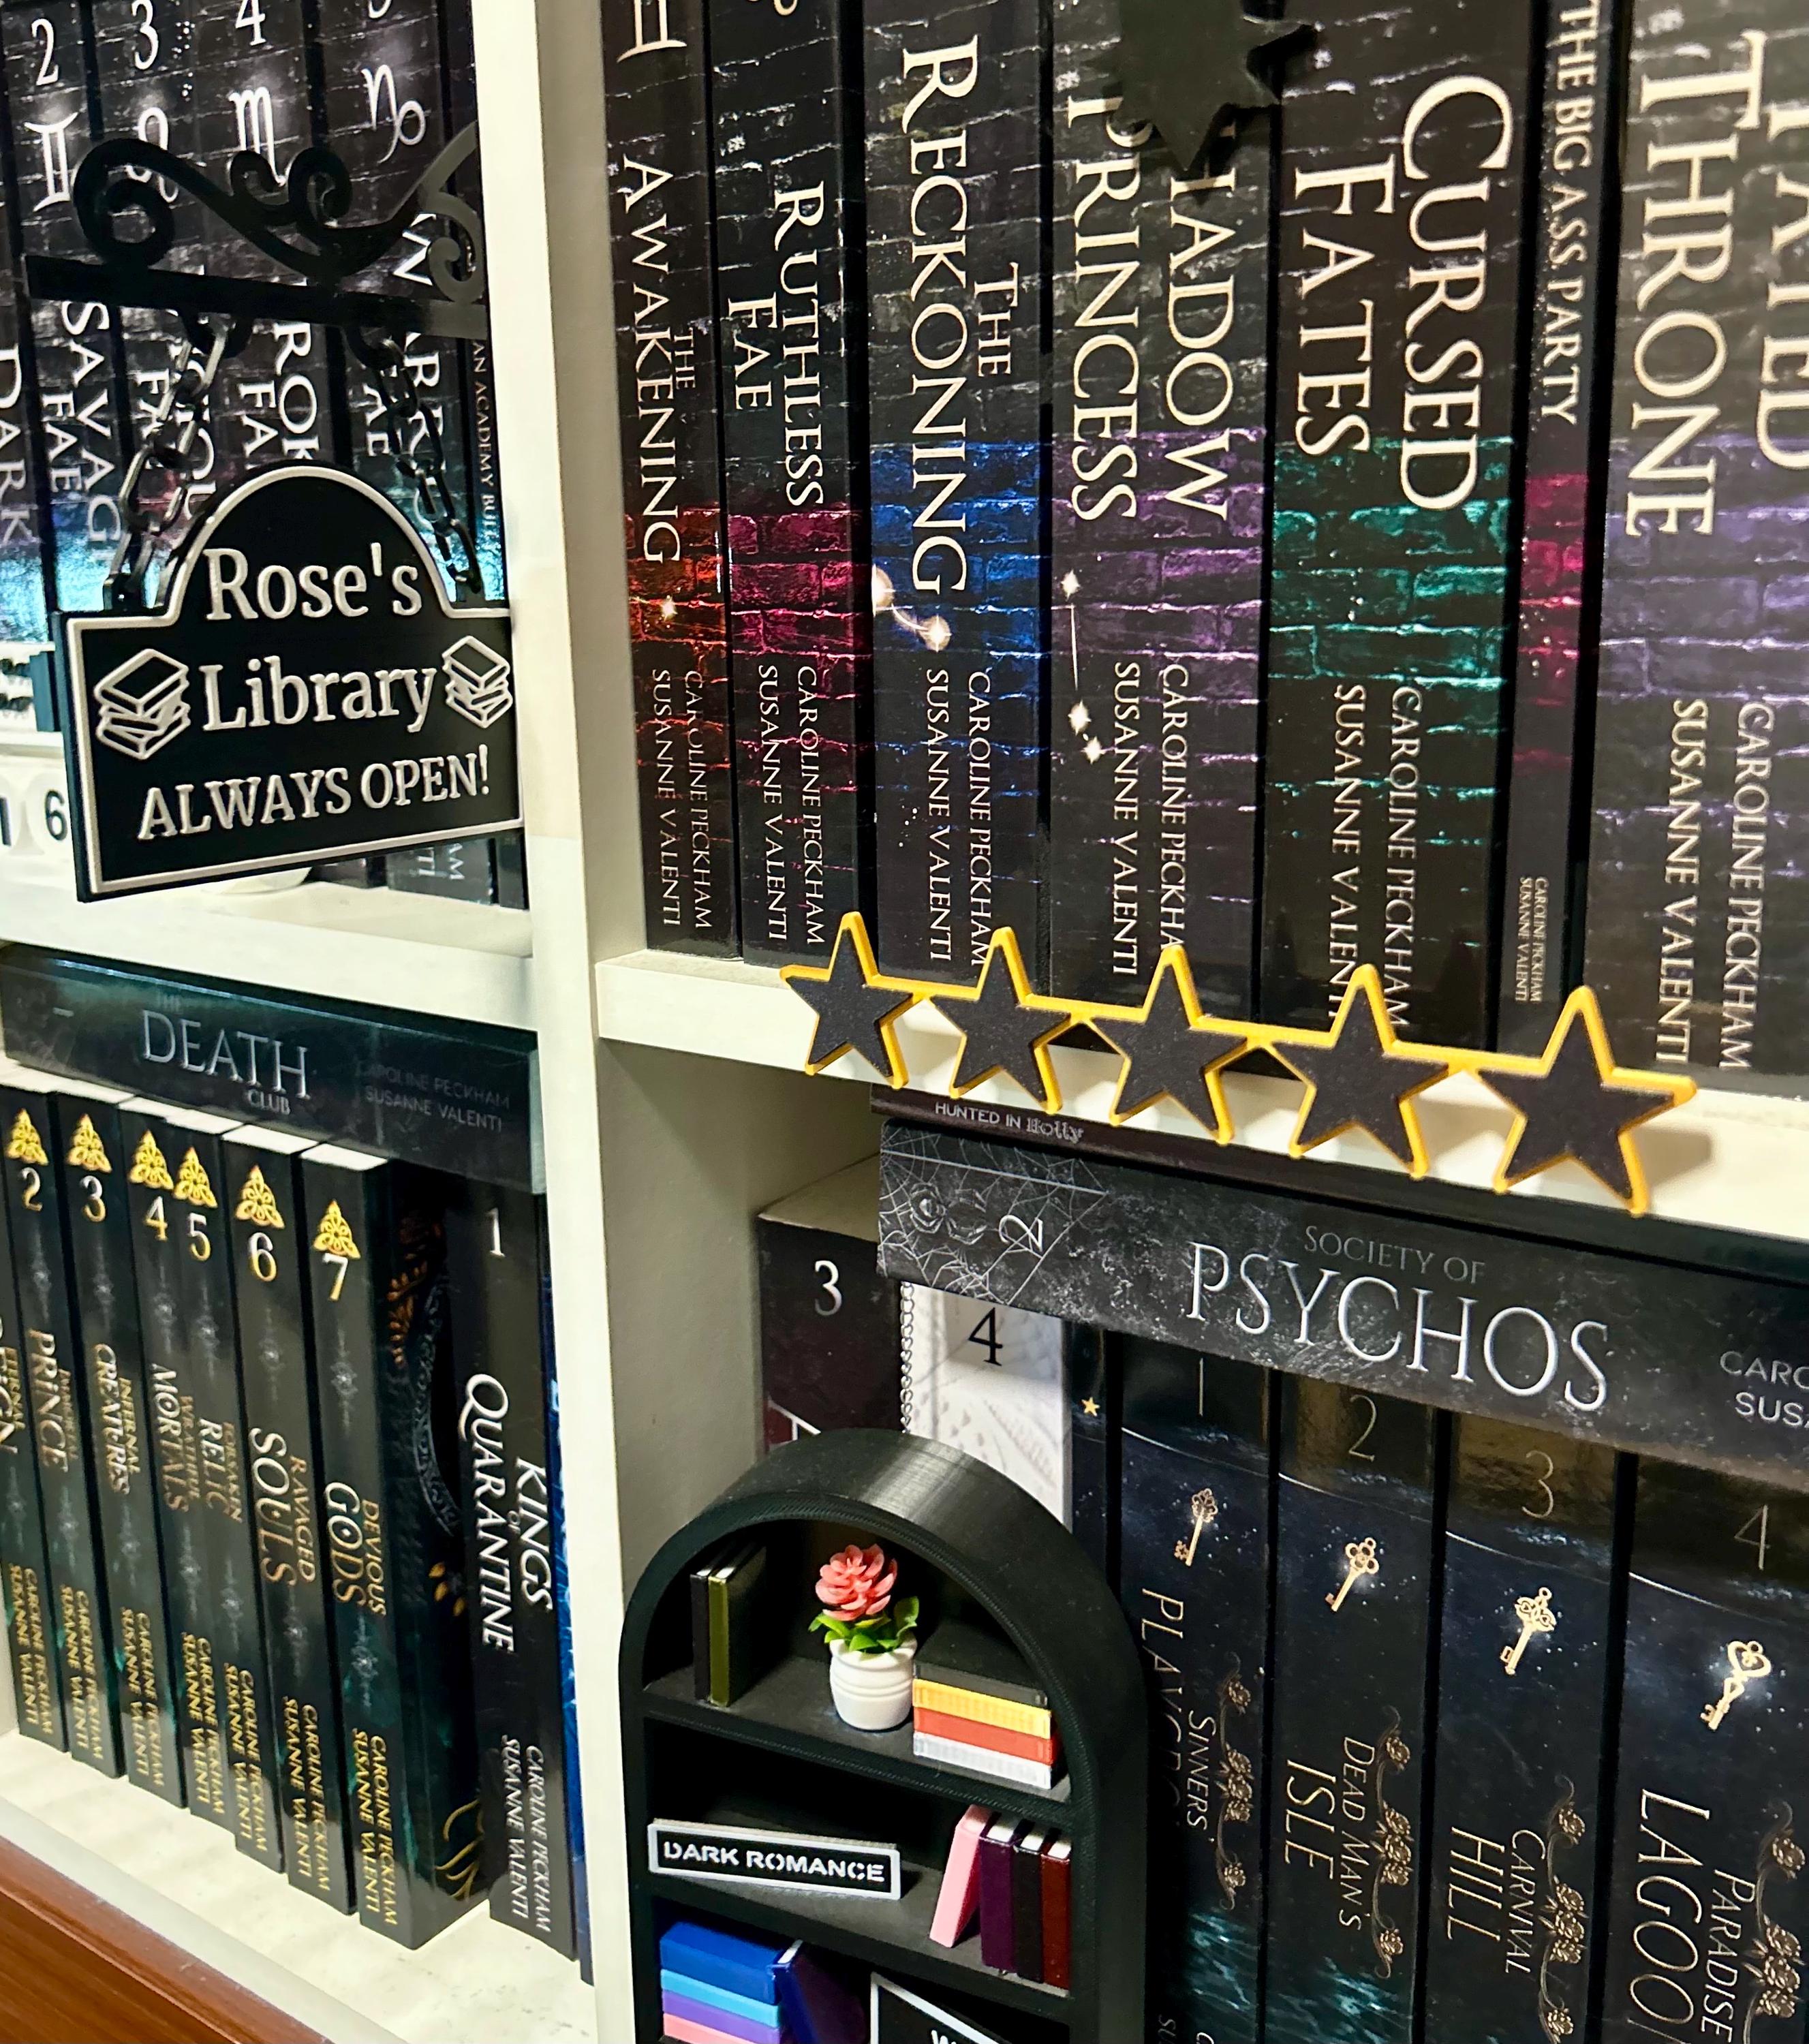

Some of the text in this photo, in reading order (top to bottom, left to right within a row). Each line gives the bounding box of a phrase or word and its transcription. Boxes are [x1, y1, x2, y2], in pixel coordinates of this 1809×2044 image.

[31, 18, 59, 86] 2
[131, 0, 159, 69] 3
[1557, 0, 1600, 91] THE
[1552, 97, 1594, 171] BIG
[902, 34, 978, 596] RECKONING
[974, 262, 1019, 377] THE
[1066, 95, 1153, 522] PRINCESS
[1295, 153, 1396, 456] FATES
[1400, 75, 1513, 511] CURSED
[1625, 29, 1769, 538] THRONE
[472, 343, 486, 373] AN
[621, 153, 681, 563] AWAKENING
[673, 328, 696, 389] THE
[728, 292, 777, 410] FAE
[774, 181, 825, 508] RUTHLESS
[1541, 276, 1586, 425] PARTY
[42, 392, 83, 493] FAE
[61, 301, 121, 562] SAVAG
[475, 382, 495, 487] ACADEMY
[203, 542, 422, 621] Rose's
[199, 655, 436, 733] Library
[45, 789, 68, 841] 6
[138, 744, 489, 840] ALWAYS OPEN!
[651, 669, 680, 926] SUSANNE VALENTI
[683, 670, 712, 929] CAROLINE PECKHAM
[758, 665, 788, 942] SUSANNE VALENTI
[797, 666, 826, 945] CAROLINE PECKHAM
[926, 669, 952, 962] SUSANNE VALENTI
[968, 671, 993, 966] CAROLINE PECKHAM
[1112, 662, 1141, 975] SUSANNE VALENTI
[1160, 663, 1190, 950] CAROLINE PECKHA
[1331, 684, 1367, 854] SUSANNE
[1382, 685, 1423, 1027] CAROLINE PECKHAM
[1655, 698, 1710, 1064] SUSANNE VALENTI
[1718, 700, 1776, 1070] CAROLINE PECKHAM
[141, 1009, 311, 1100] DEATH
[247, 1089, 291, 1115] CLUB
[365, 1085, 503, 1134] SUSANNE VALENTI
[433, 1077, 510, 1110] PECKHAM
[935, 1102, 1000, 1124] HUNTED
[1006, 1113, 1021, 1129] IN
[21, 1167, 43, 1212] 2
[80, 1175, 106, 1222] 3
[144, 1196, 169, 1242] 4
[187, 1213, 211, 1262] 5
[486, 1208, 506, 1258] 1
[248, 1233, 277, 1282] 6
[322, 1255, 350, 1302] 7
[814, 1260, 843, 1316] 3
[1305, 1225, 1486, 1284] SOCIETY OF
[968, 1307, 1004, 1367] 4
[1186, 1240, 1611, 1412] PSYCHOS
[27, 1329, 69, 1473] PRINCE
[151, 1363, 189, 1513] MORTALS
[1347, 1394, 1378, 1461] 2
[199, 1418, 230, 1510] RELIC
[249, 1427, 298, 1587] SOULS
[289, 1455, 315, 1583] RAVAGED
[459, 1374, 515, 1654] QUARANTINE
[1521, 1450, 1554, 1520] 3
[324, 1482, 367, 1607] GODS
[362, 1499, 387, 1616] DEVIOUS
[514, 1457, 553, 1613] KINGS
[1734, 1503, 1769, 1570] 4
[663, 1841, 885, 1883] DARK ROMANCE
[1284, 1759, 1337, 1880] ISLE
[1338, 1736, 1375, 1932] DEAD MAN'S
[1446, 1826, 1505, 1942] HILL
[1504, 1829, 1547, 1975] CARNIVAL
[1700, 1869, 1757, 2044] PARADISE
